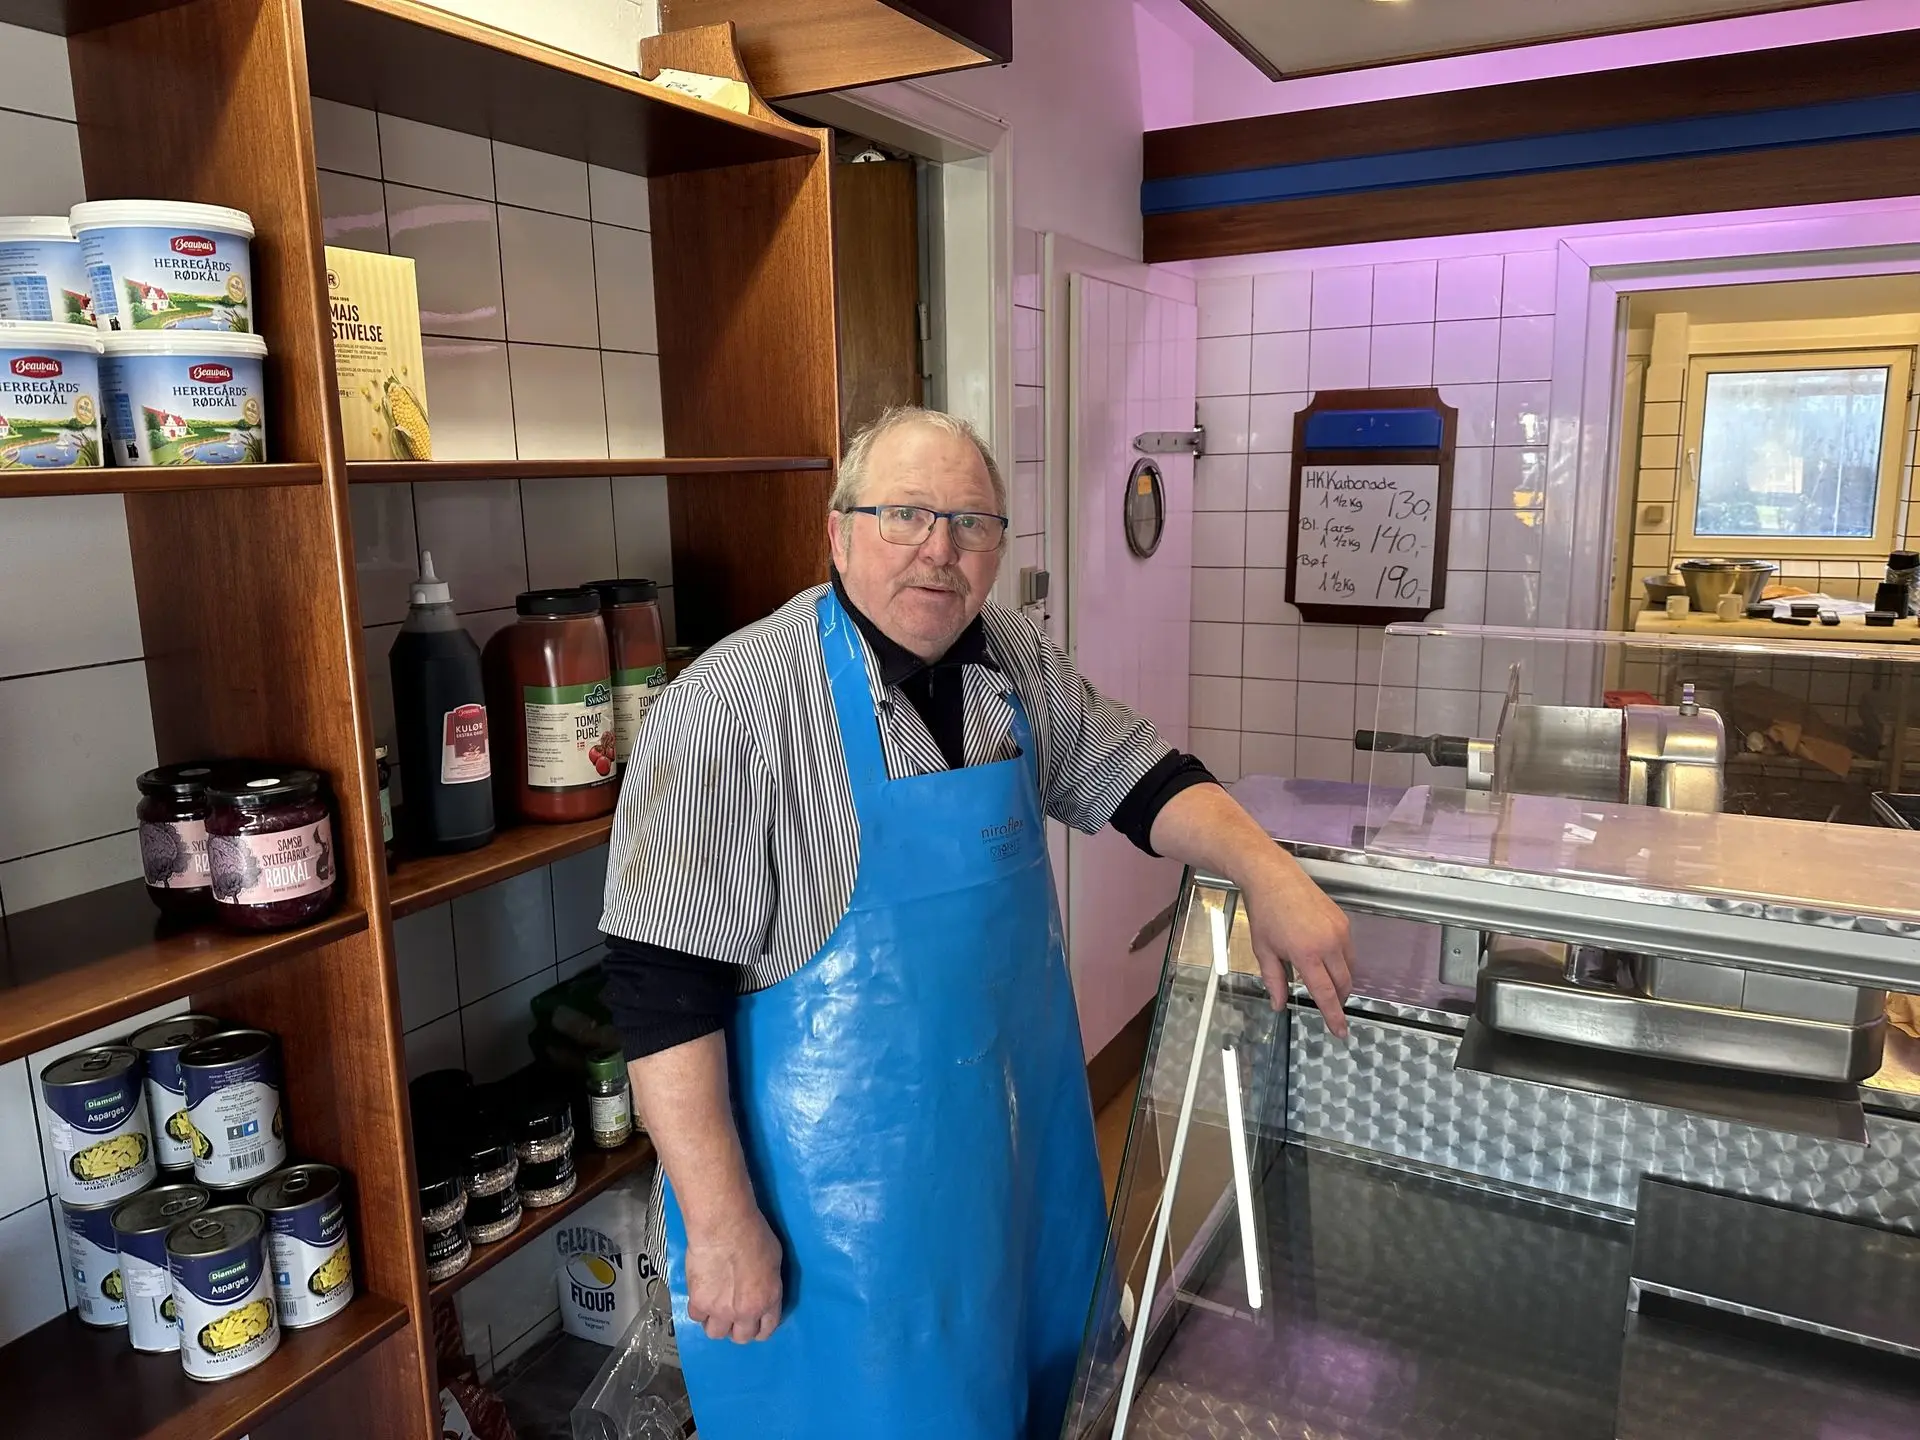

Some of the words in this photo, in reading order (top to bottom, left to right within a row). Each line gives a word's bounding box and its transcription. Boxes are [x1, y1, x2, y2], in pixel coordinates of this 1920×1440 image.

[175, 238, 213, 251] Beauvais
[154, 258, 231, 272] HERREGÅRDS
[174, 270, 220, 282] RØDKÅL
[330, 303, 359, 322] MAJS
[331, 322, 384, 342] STIVELSE
[15, 360, 59, 374] Beauvais
[193, 367, 230, 379] Beauvais
[15, 391, 68, 405] RØDKÅL
[172, 384, 247, 397] HERREGÅRDS
[192, 396, 237, 408] RØDKÅL
[1323, 517, 1355, 536] fars
[574, 713, 602, 728] TOMAT
[455, 723, 483, 734] KULØR
[265, 861, 312, 888] RØDKÅL
[88, 1093, 122, 1108] Diamond
[87, 1106, 125, 1123] Asparges
[556, 1227, 623, 1270] GLUTEN
[212, 1262, 246, 1280] Diamond
[211, 1276, 249, 1295] Asparges
[570, 1282, 616, 1312] FLOUR
